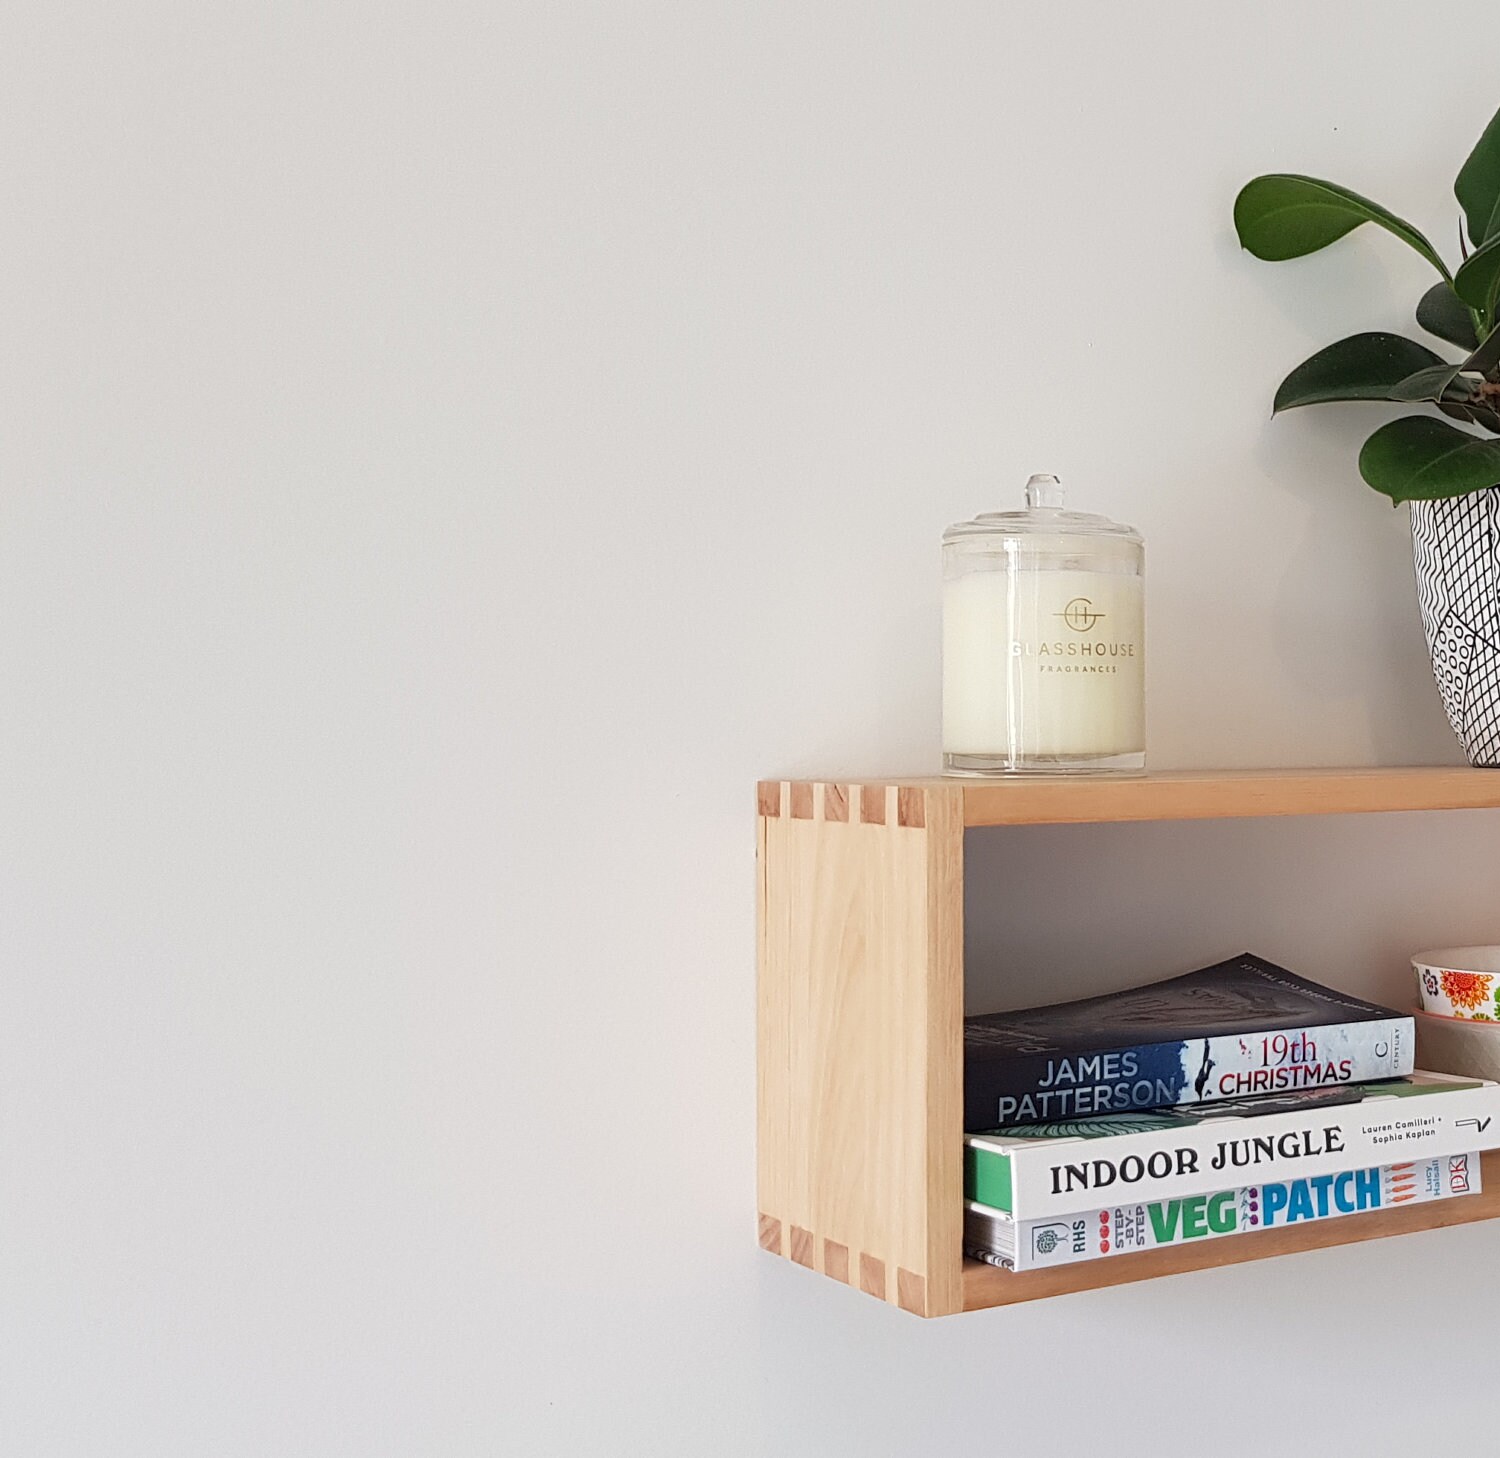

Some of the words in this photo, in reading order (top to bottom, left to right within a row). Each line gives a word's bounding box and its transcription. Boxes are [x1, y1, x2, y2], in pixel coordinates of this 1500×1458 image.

[1010, 641, 1134, 657] GLASSHOUSE
[1040, 665, 1117, 673] FRAGRANCES
[1260, 1031, 1317, 1067] 19th
[1037, 1051, 1139, 1088] JAMES
[1218, 1059, 1352, 1096] CHRISTMAS
[998, 1077, 1177, 1123] PATTERSON
[1362, 1122, 1392, 1134] Lauren
[1395, 1116, 1435, 1129] Camilleri
[1372, 1132, 1403, 1144] Sophia
[1405, 1129, 1436, 1141] Kaplan
[1050, 1148, 1199, 1194] INDOOR
[1211, 1125, 1346, 1170] JUNGLE
[1450, 1158, 1466, 1190] DK
[1425, 1166, 1433, 1192] Lucy
[1147, 1190, 1238, 1243] VEG
[1262, 1166, 1382, 1227] PATCH
[1072, 1219, 1086, 1253] RHS
[1115, 1207, 1124, 1249] STEP
[1136, 1205, 1145, 1246] STEP
